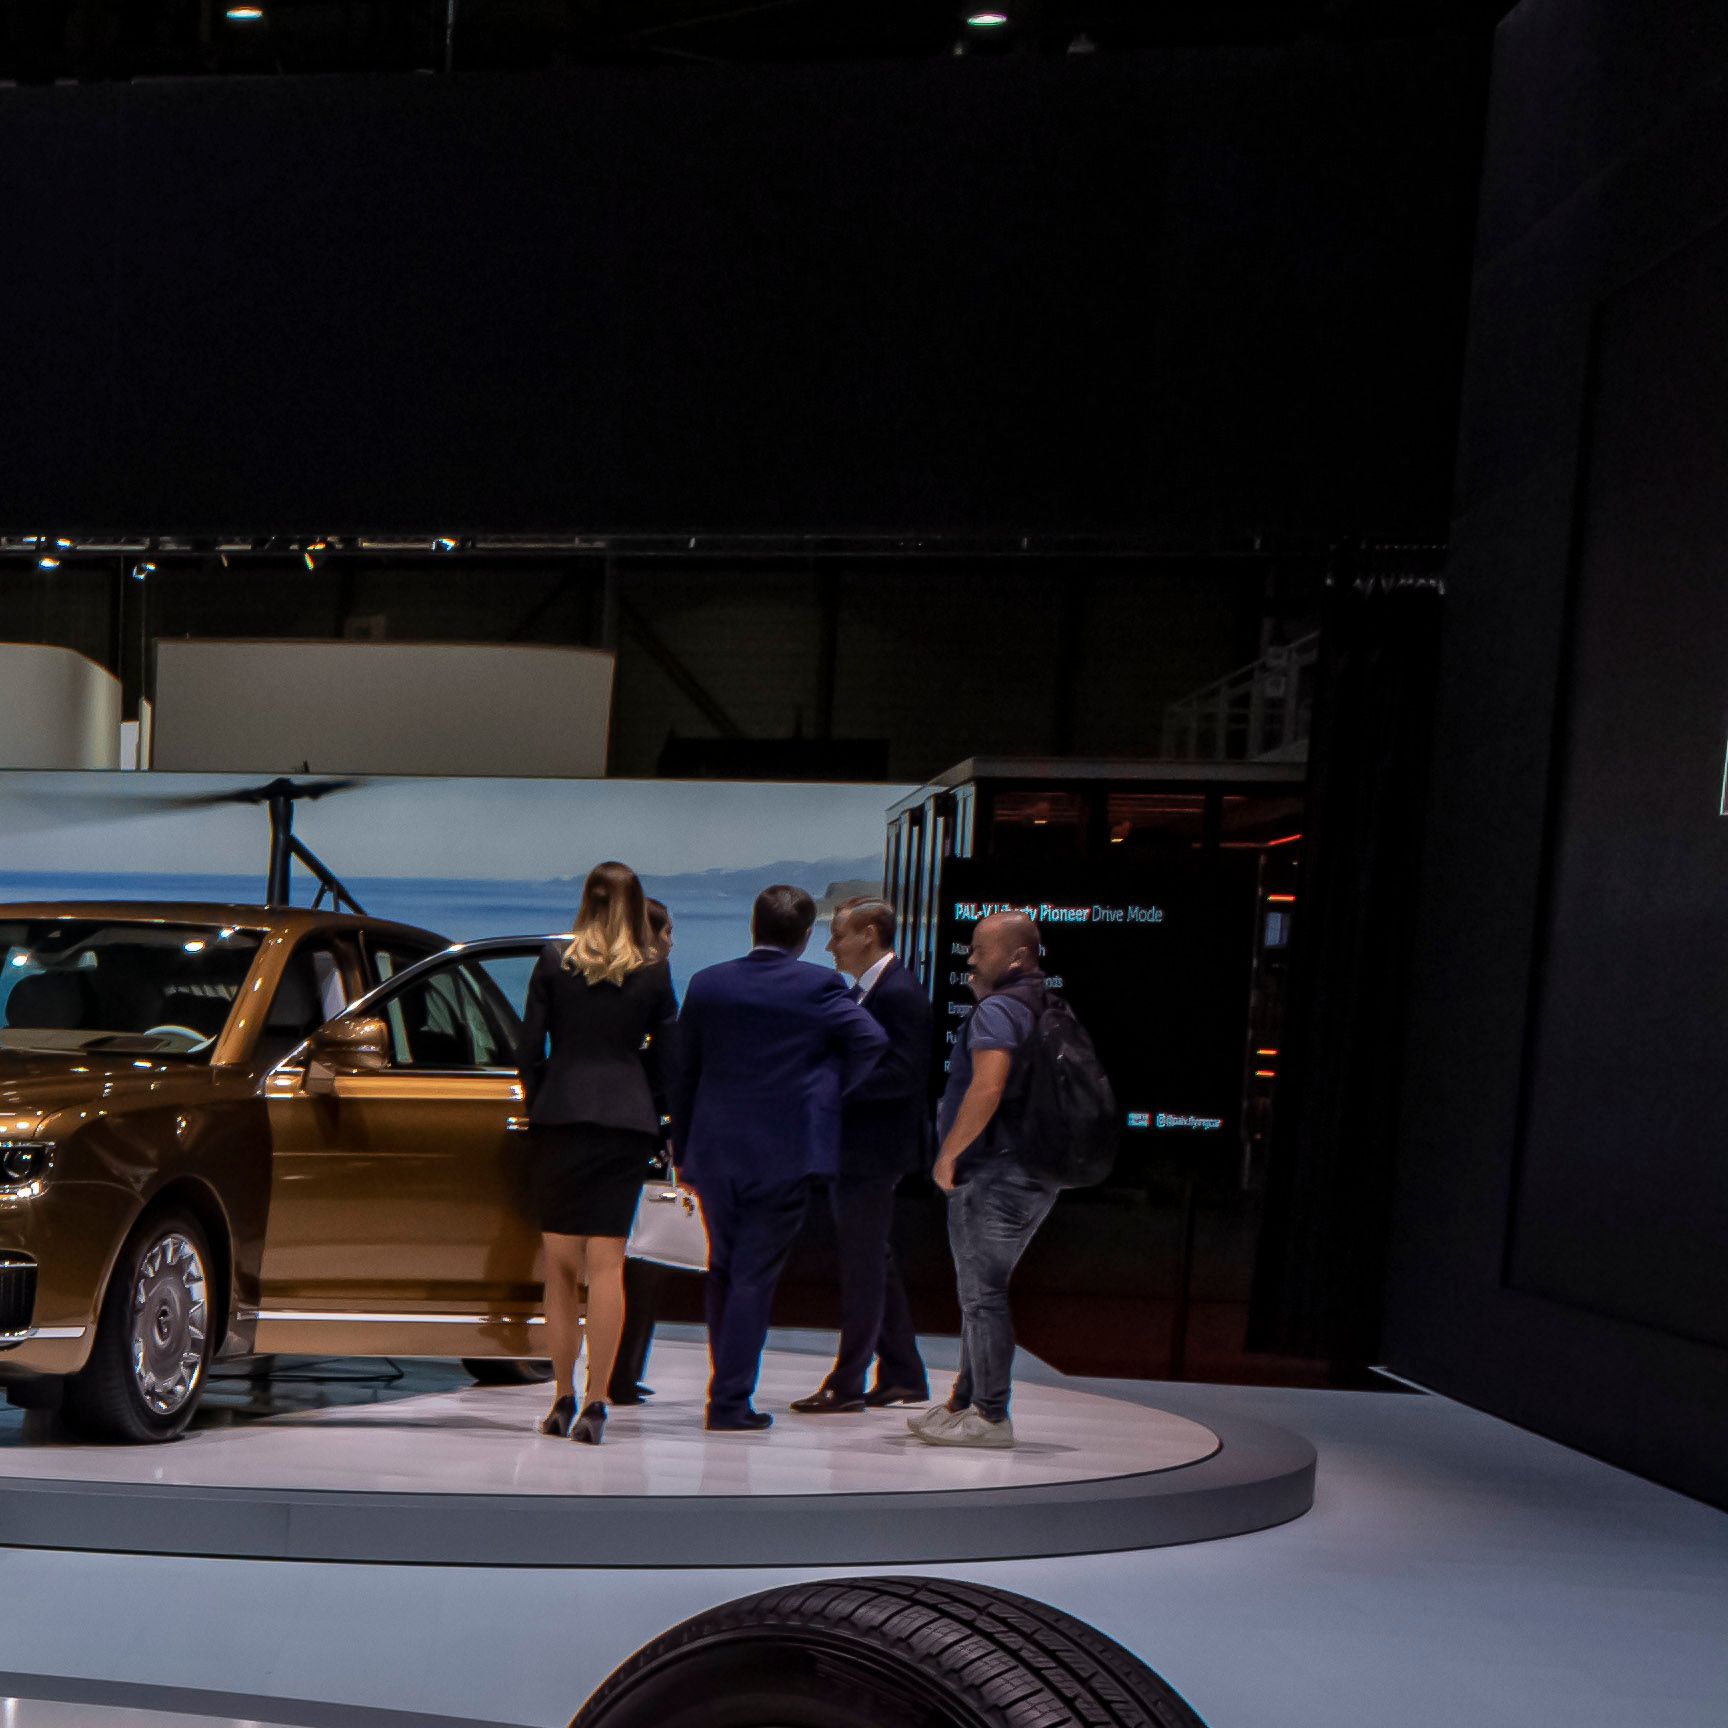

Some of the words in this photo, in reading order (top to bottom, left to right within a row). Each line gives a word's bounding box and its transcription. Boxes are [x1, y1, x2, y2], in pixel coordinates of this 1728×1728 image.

[1039, 903, 1091, 921] Pioneer
[1092, 905, 1124, 921] Drive
[1127, 905, 1163, 922] Mode
